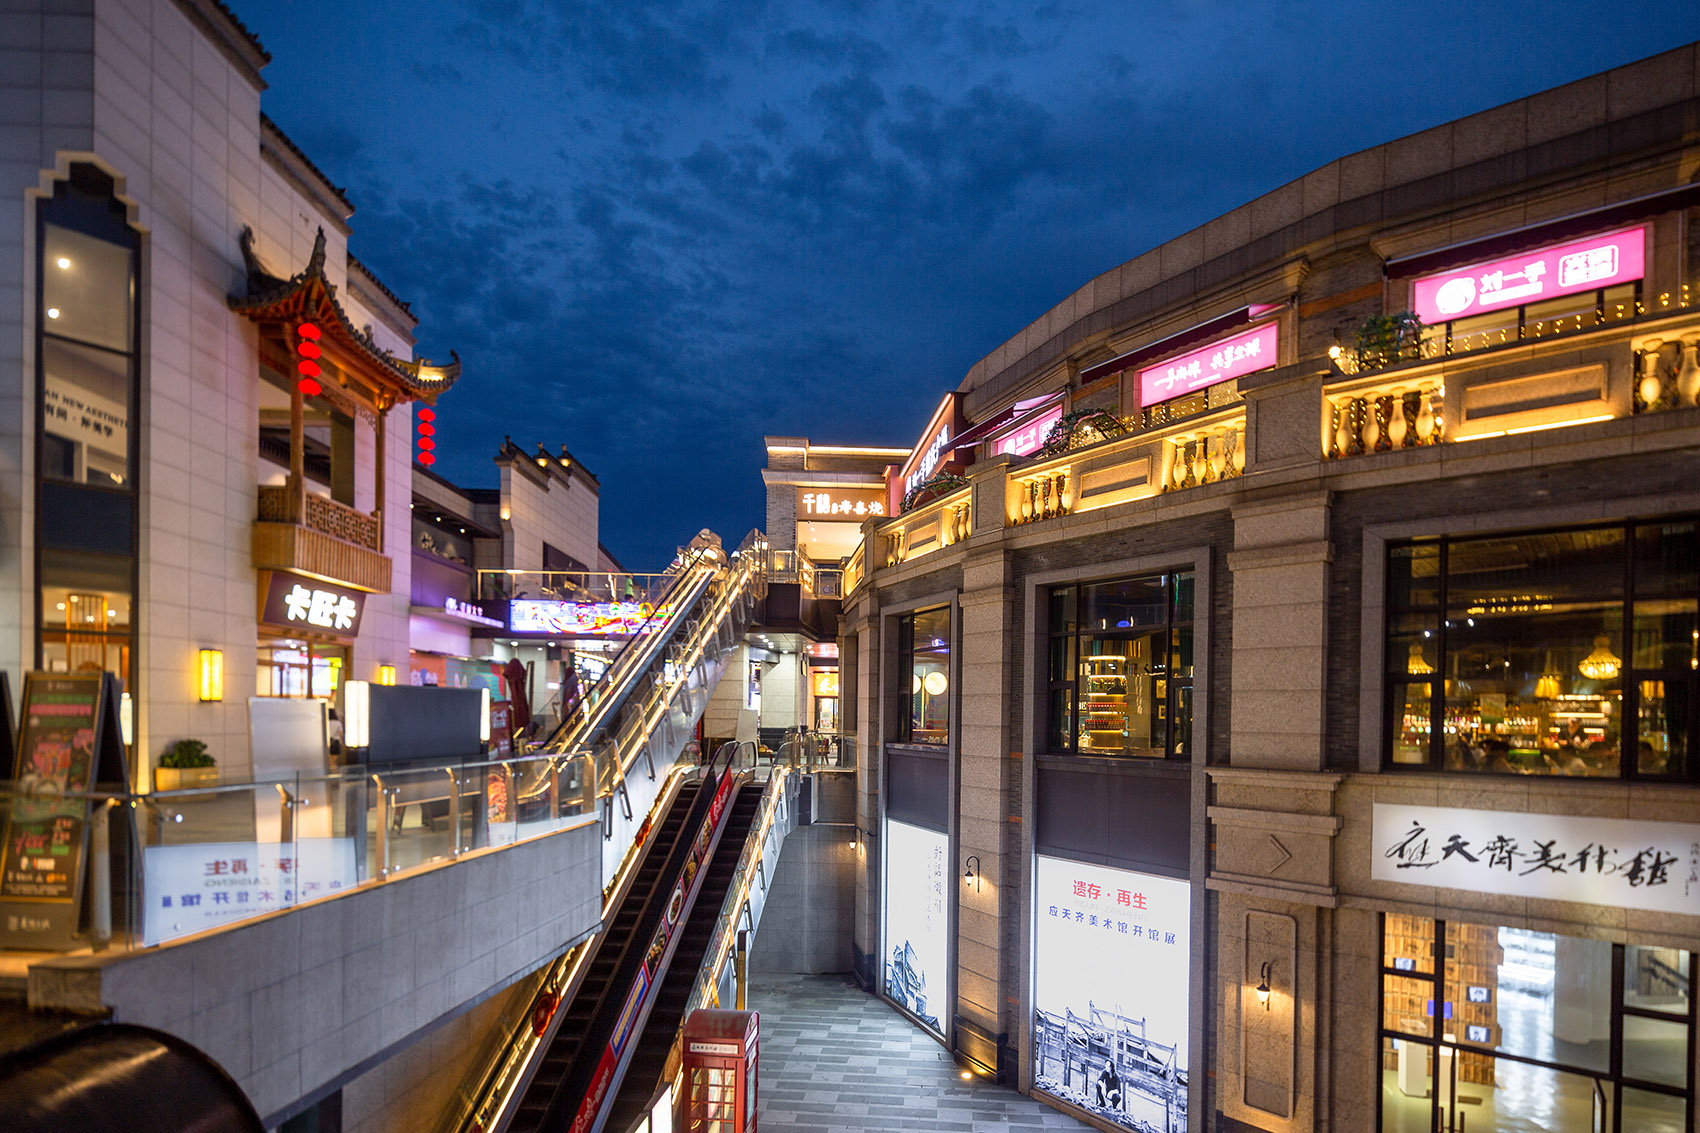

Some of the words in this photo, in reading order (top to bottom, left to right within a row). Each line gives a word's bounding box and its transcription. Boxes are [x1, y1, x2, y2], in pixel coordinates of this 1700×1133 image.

[284, 584, 357, 630] 卡旺卡
[1049, 905, 1176, 945] 应天齐美术馆开馆展
